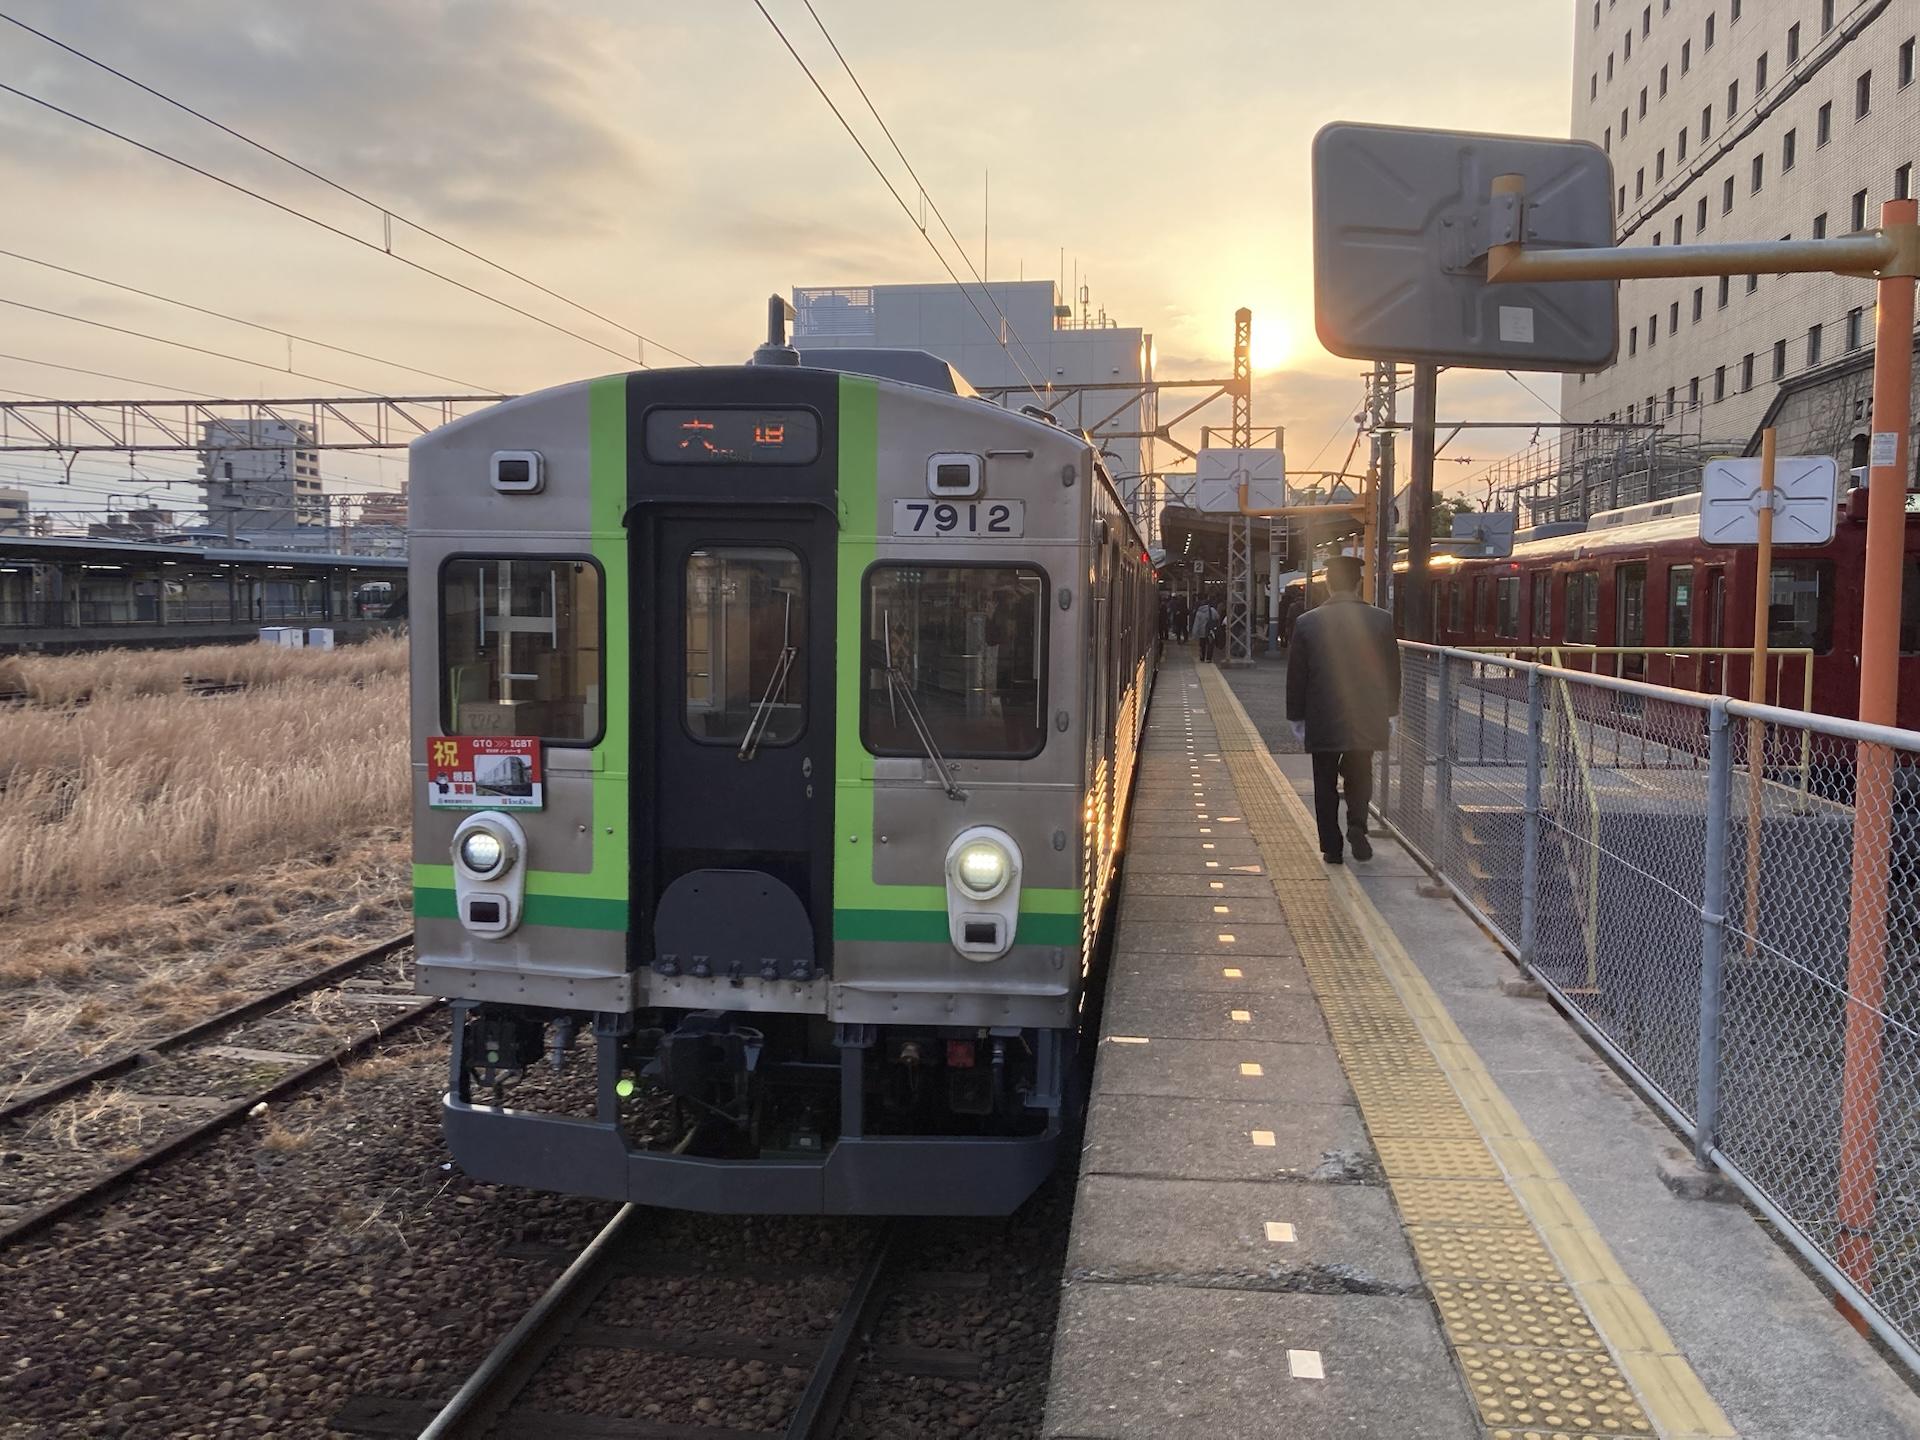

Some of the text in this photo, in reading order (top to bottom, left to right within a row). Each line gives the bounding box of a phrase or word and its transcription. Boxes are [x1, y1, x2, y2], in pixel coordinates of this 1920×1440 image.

[906, 504, 1011, 532] 7912
[434, 741, 459, 767] 祝
[472, 739, 533, 748] GTO IGBT
